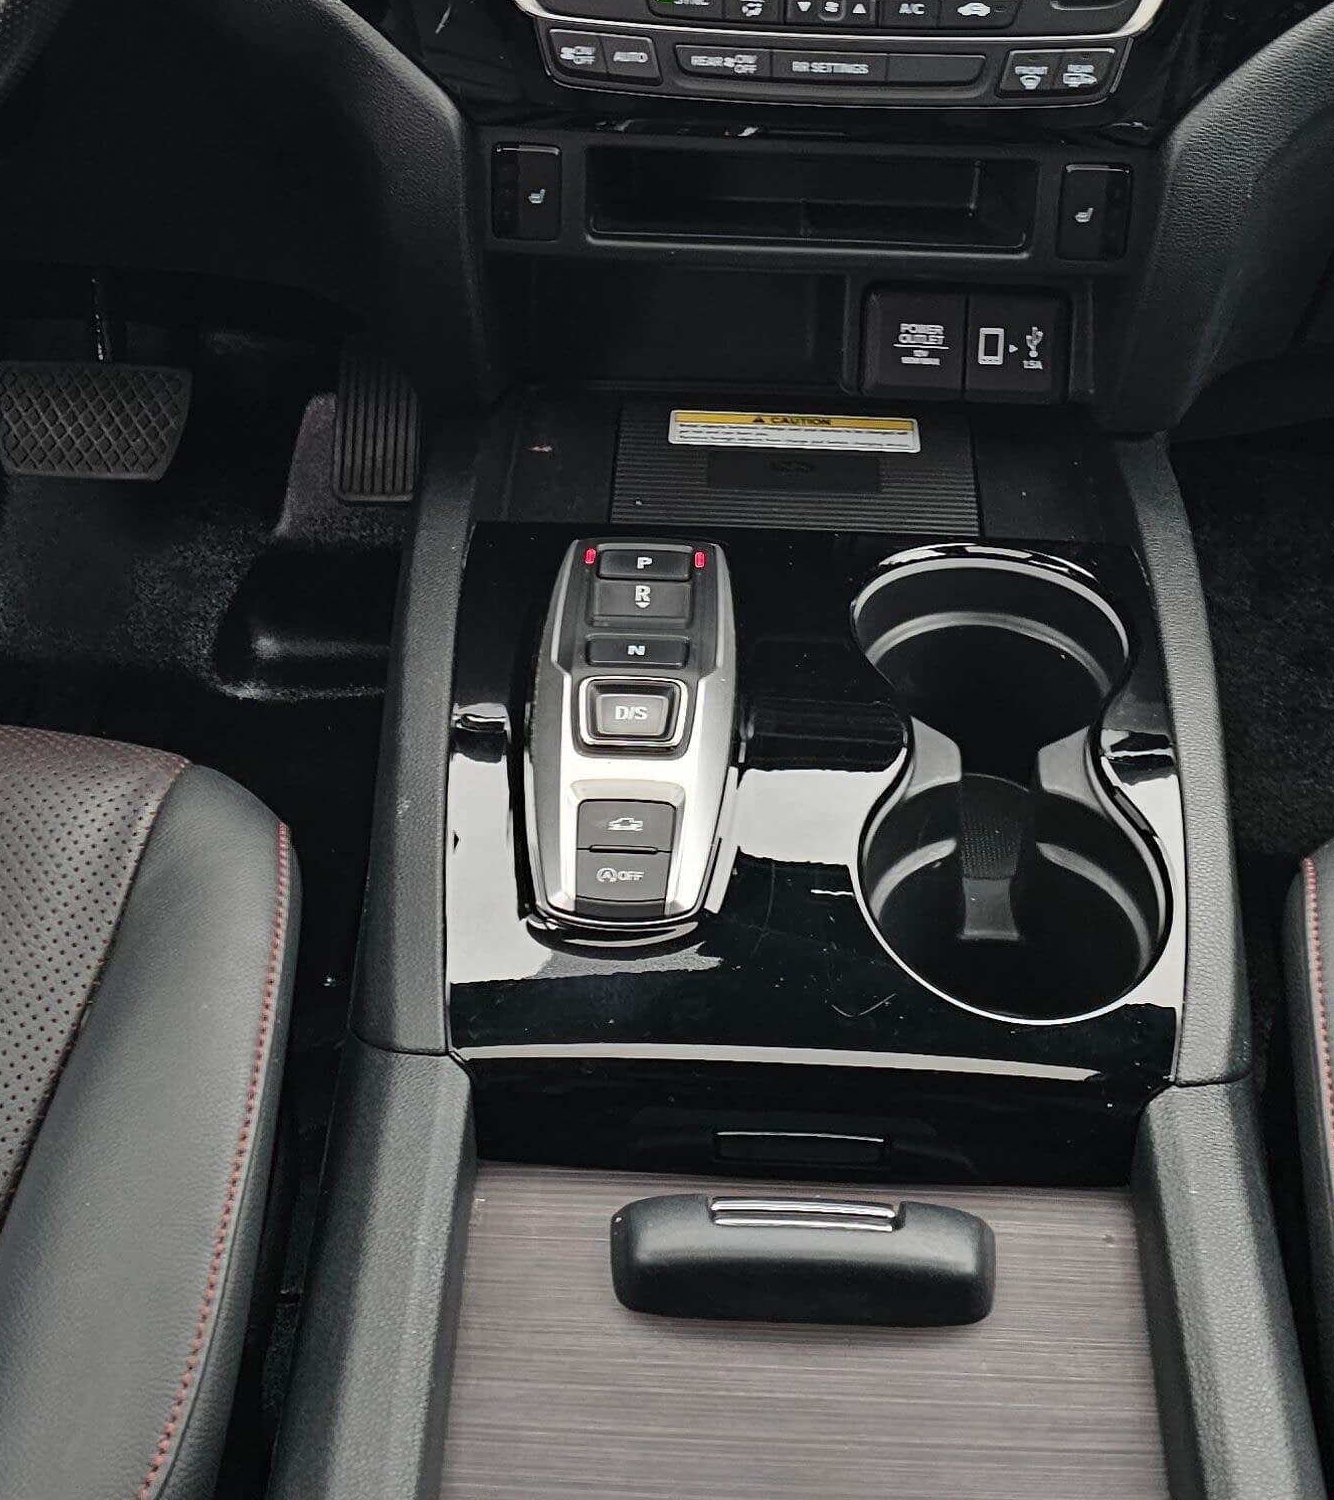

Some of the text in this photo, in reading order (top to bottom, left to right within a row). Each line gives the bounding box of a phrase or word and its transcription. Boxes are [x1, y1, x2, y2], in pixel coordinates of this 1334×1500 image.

[613, 51, 649, 63] AUTO
[690, 55, 724, 67] REAR
[810, 61, 869, 75] SETTINGS
[900, 323, 945, 335] POWER
[898, 333, 945, 345] OUTLET
[770, 416, 831, 426] CAUTION
[636, 556, 653, 569] P
[635, 585, 651, 602] R
[627, 644, 646, 656] N
[615, 705, 649, 721] D/S
[617, 871, 644, 882] OFF
